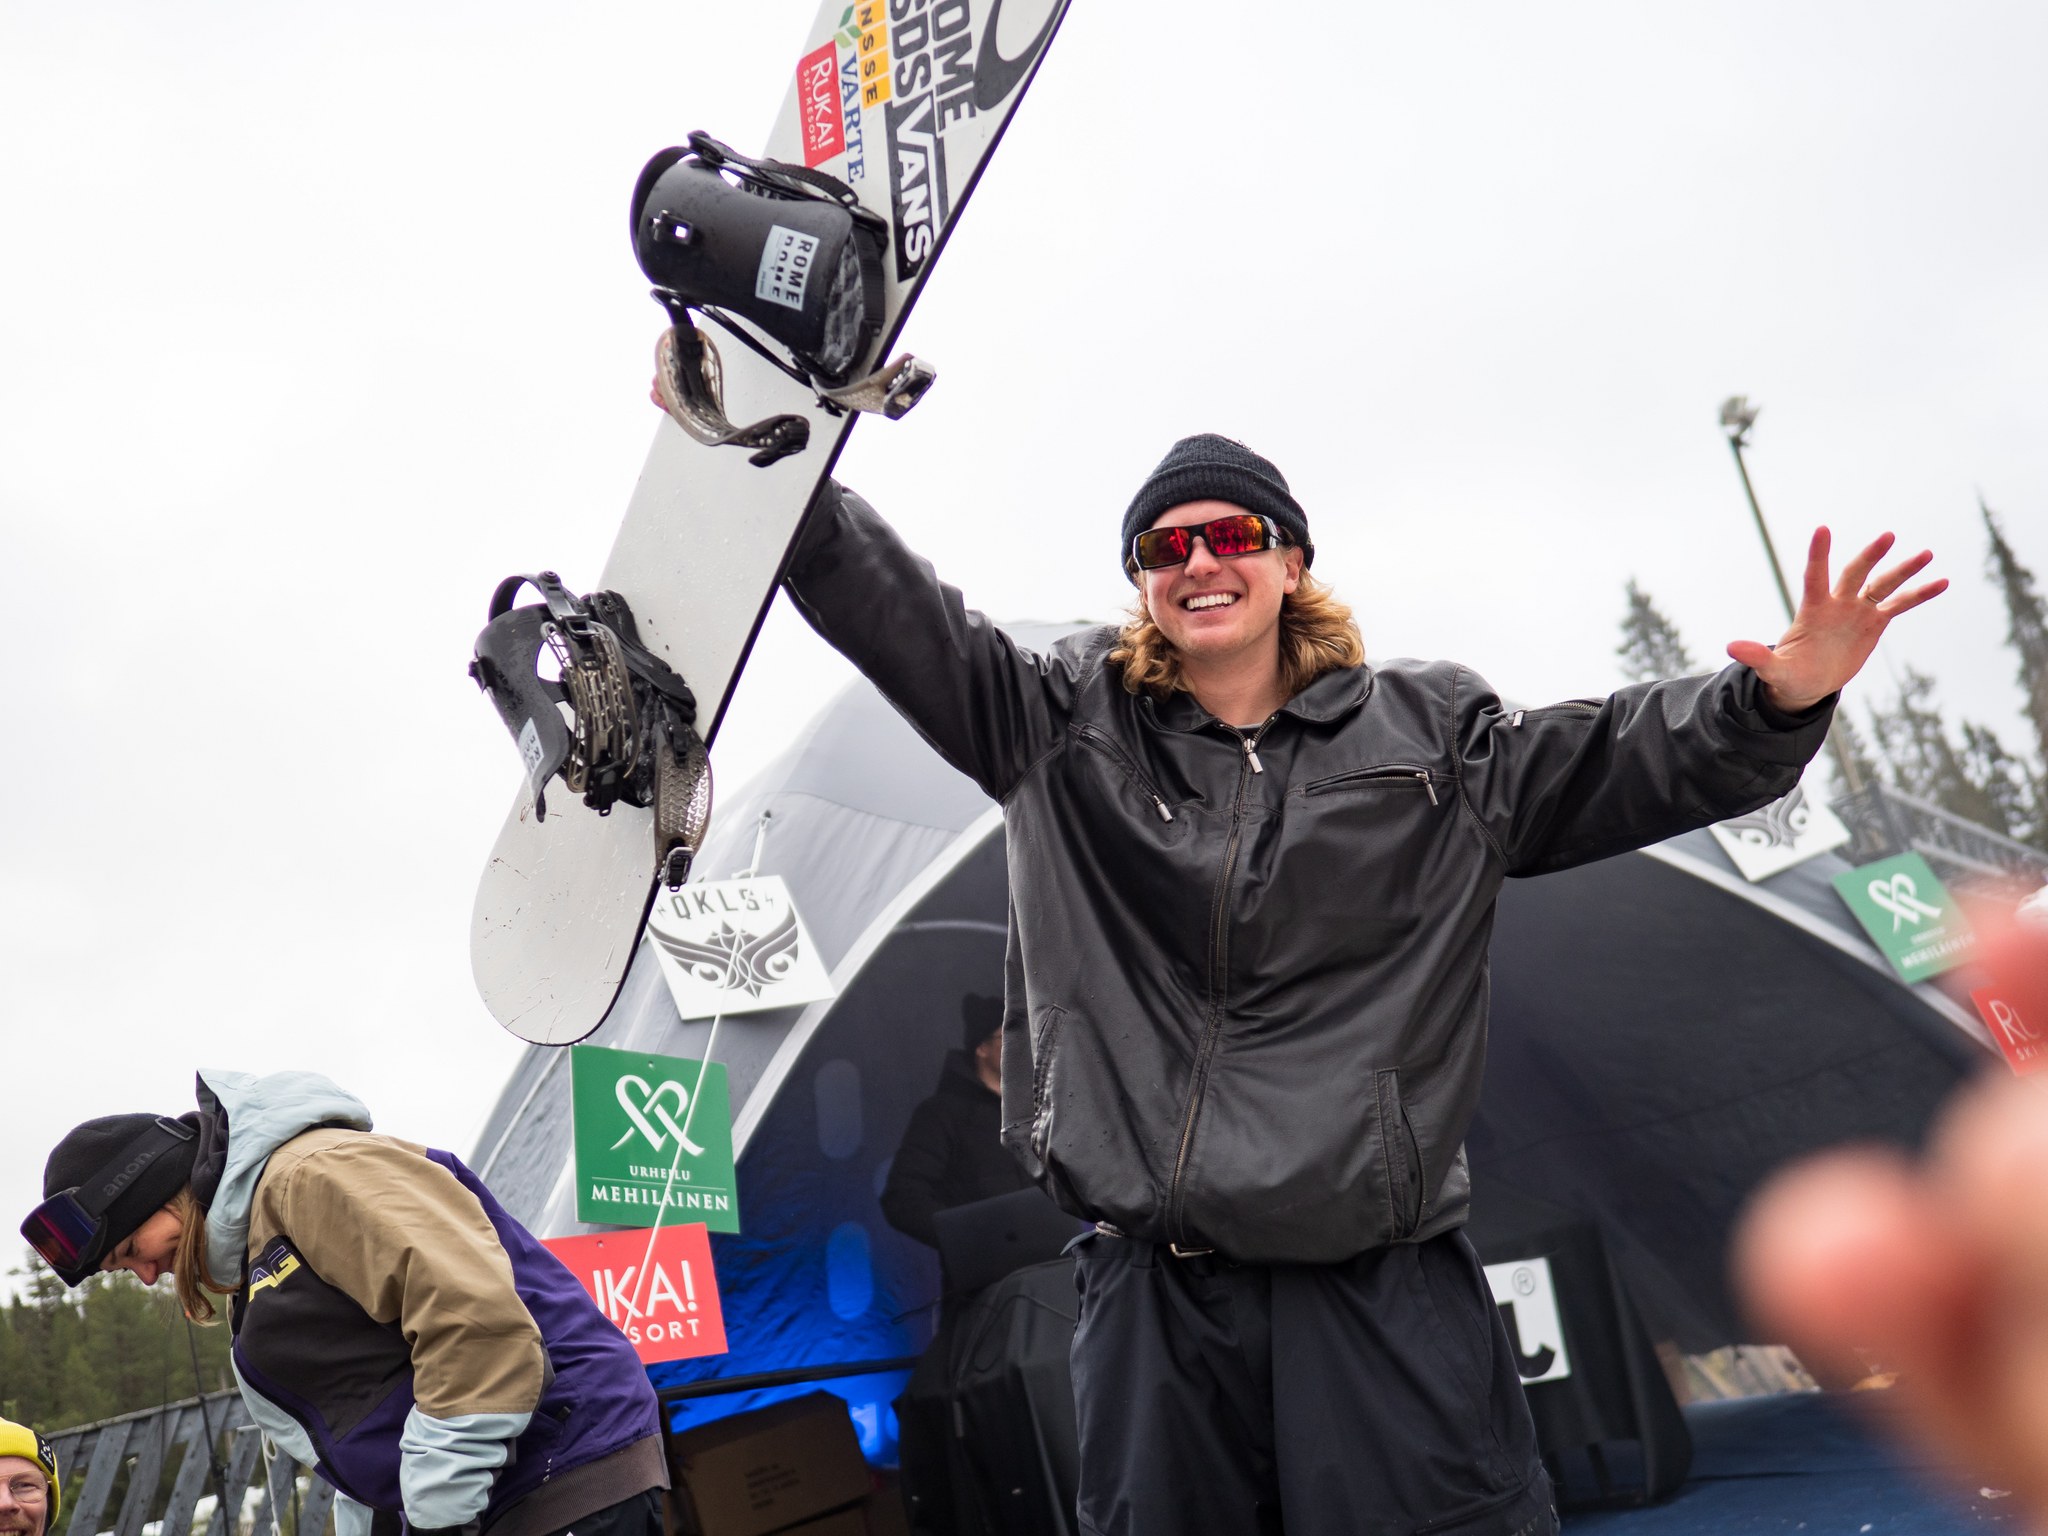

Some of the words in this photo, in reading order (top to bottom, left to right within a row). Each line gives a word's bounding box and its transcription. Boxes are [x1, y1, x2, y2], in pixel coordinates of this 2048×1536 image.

[859, 6, 878, 105] NSSE
[930, 0, 977, 133] OME
[805, 97, 818, 152] RESORT
[810, 56, 835, 150] RUKA!
[841, 51, 865, 184] VARTE
[896, 94, 941, 263] VANS
[785, 239, 814, 304] ROME
[592, 1260, 698, 1321] KA!
[629, 1318, 700, 1345] SORT
